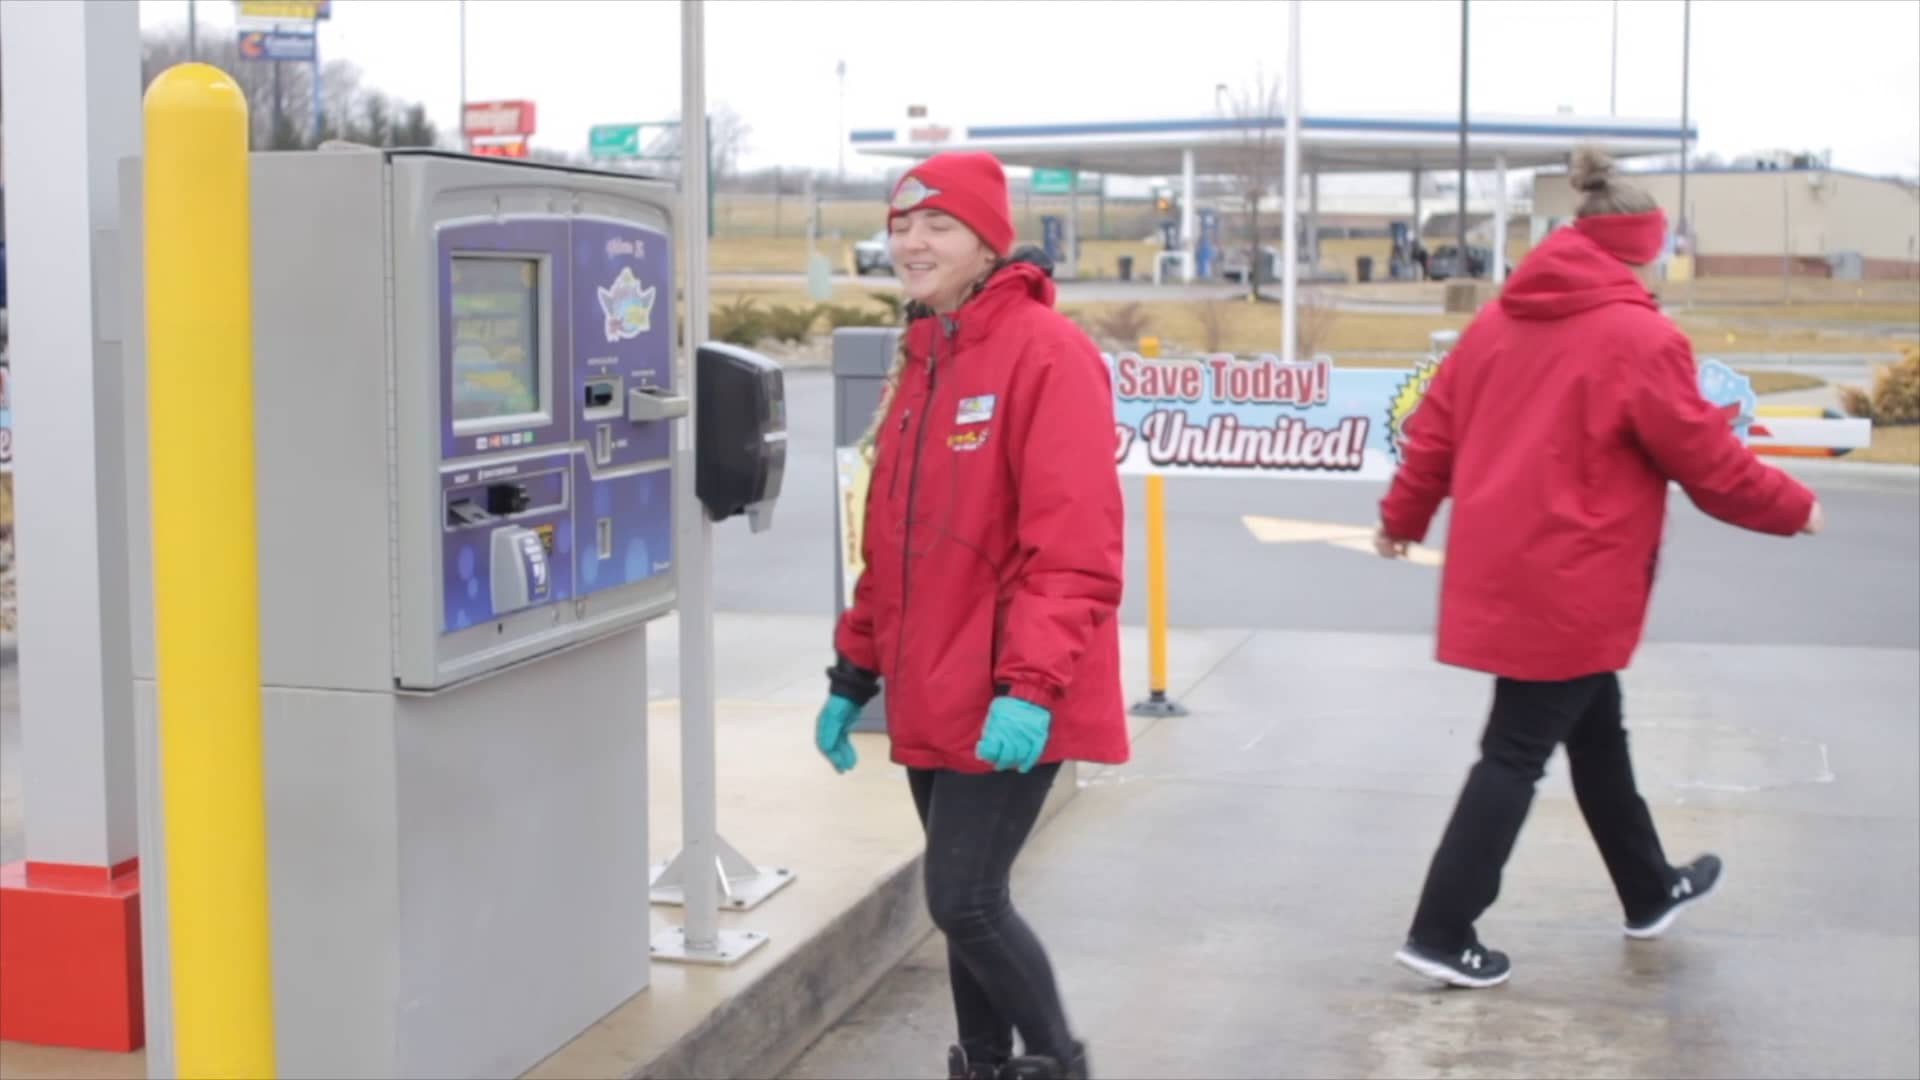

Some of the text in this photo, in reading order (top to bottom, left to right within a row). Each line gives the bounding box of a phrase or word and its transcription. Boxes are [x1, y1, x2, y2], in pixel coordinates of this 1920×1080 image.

[1117, 357, 1329, 405] Save Today!
[1140, 408, 1369, 470] Unlimited!
